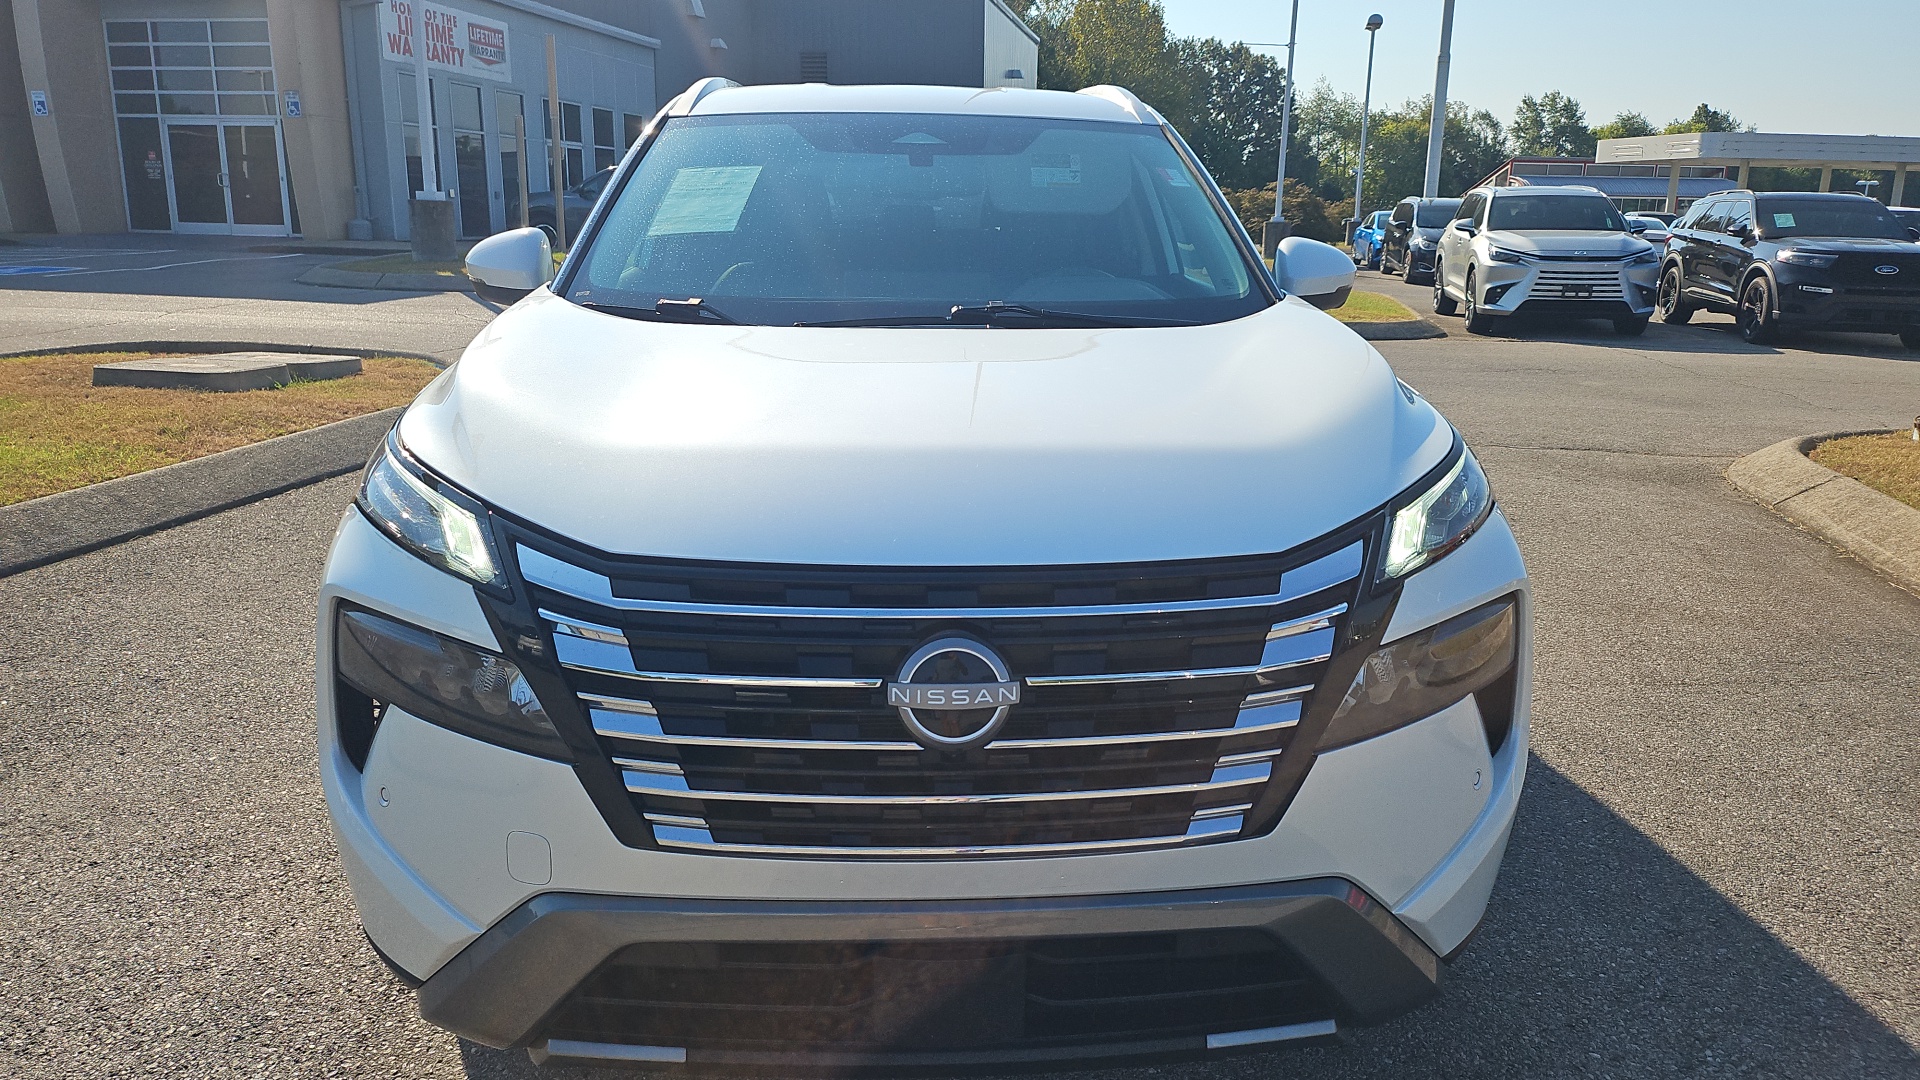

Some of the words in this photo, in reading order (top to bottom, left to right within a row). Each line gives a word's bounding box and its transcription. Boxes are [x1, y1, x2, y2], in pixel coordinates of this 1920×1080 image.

[391, 0, 412, 16] HO
[425, 8, 437, 22] OF
[440, 13, 457, 28] THE
[397, 13, 455, 46] LITIME
[470, 26, 503, 47] LIFETIME
[387, 32, 464, 67] WAANTY
[891, 686, 1017, 705] NISSAN
